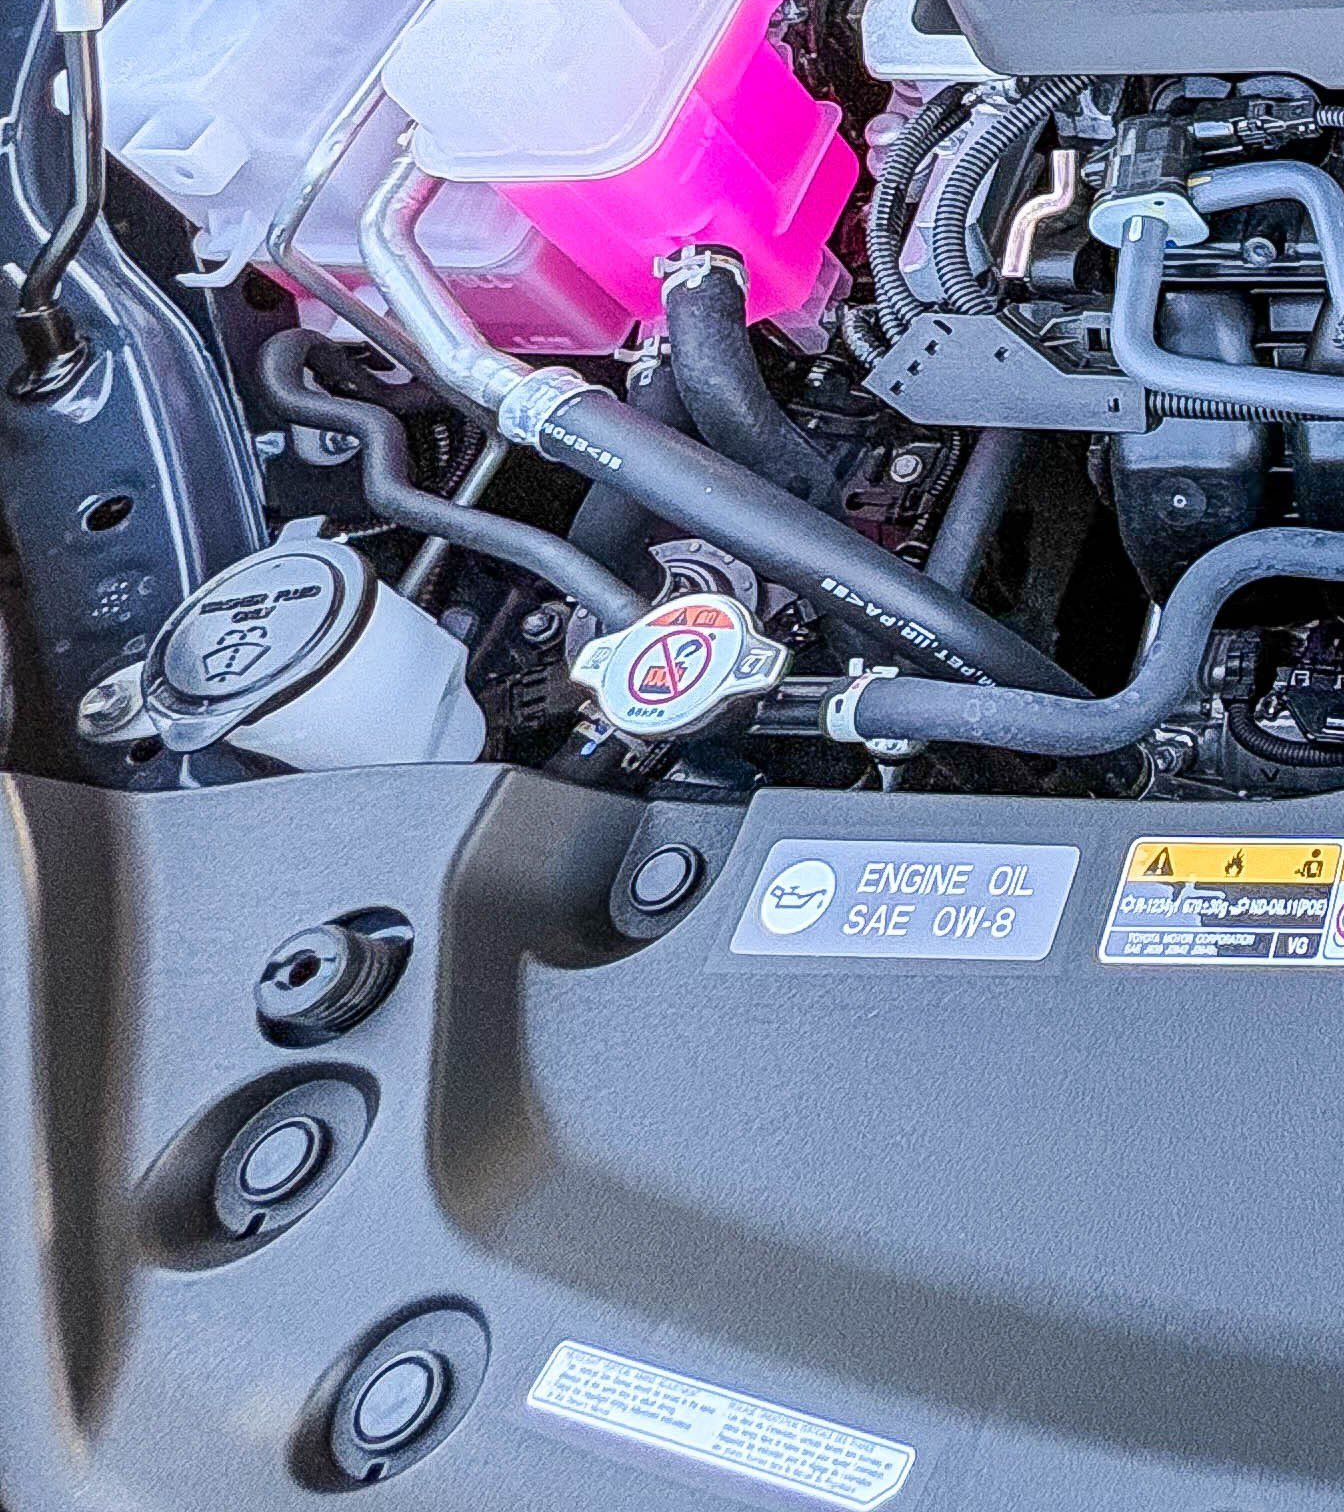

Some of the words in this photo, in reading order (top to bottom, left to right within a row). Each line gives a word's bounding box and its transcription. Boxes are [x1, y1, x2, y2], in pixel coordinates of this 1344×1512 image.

[857, 862, 974, 896] ENGINE
[988, 864, 1034, 897] OIL
[843, 904, 916, 937] SAE
